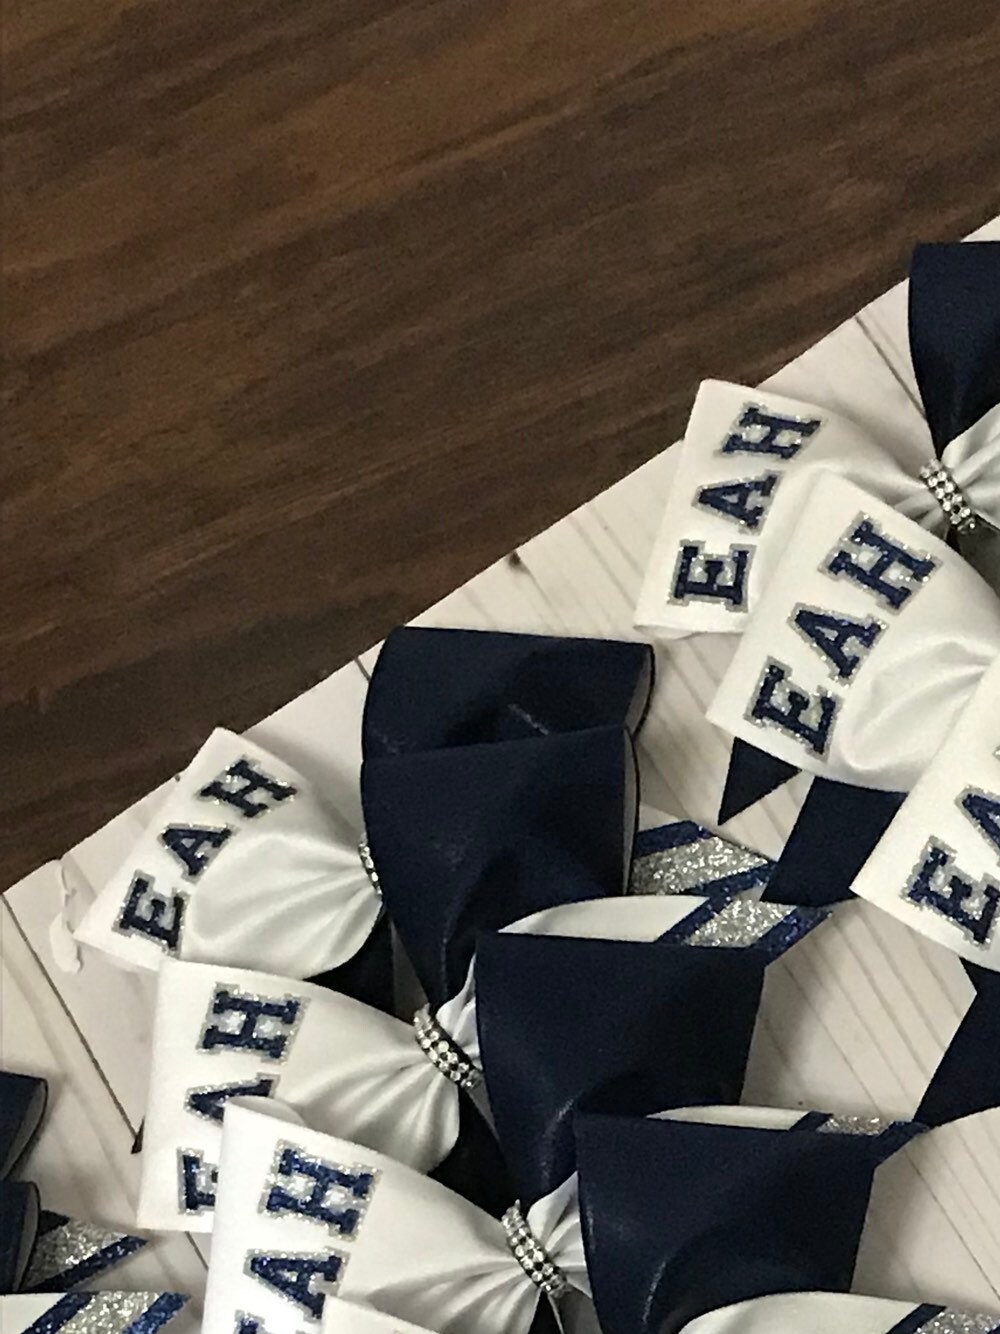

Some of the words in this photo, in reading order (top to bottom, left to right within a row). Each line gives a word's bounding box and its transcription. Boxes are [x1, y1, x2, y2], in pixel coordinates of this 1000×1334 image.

[667, 400, 826, 612] EAH
[745, 510, 941, 762] EAH
[112, 756, 299, 957] EAH
